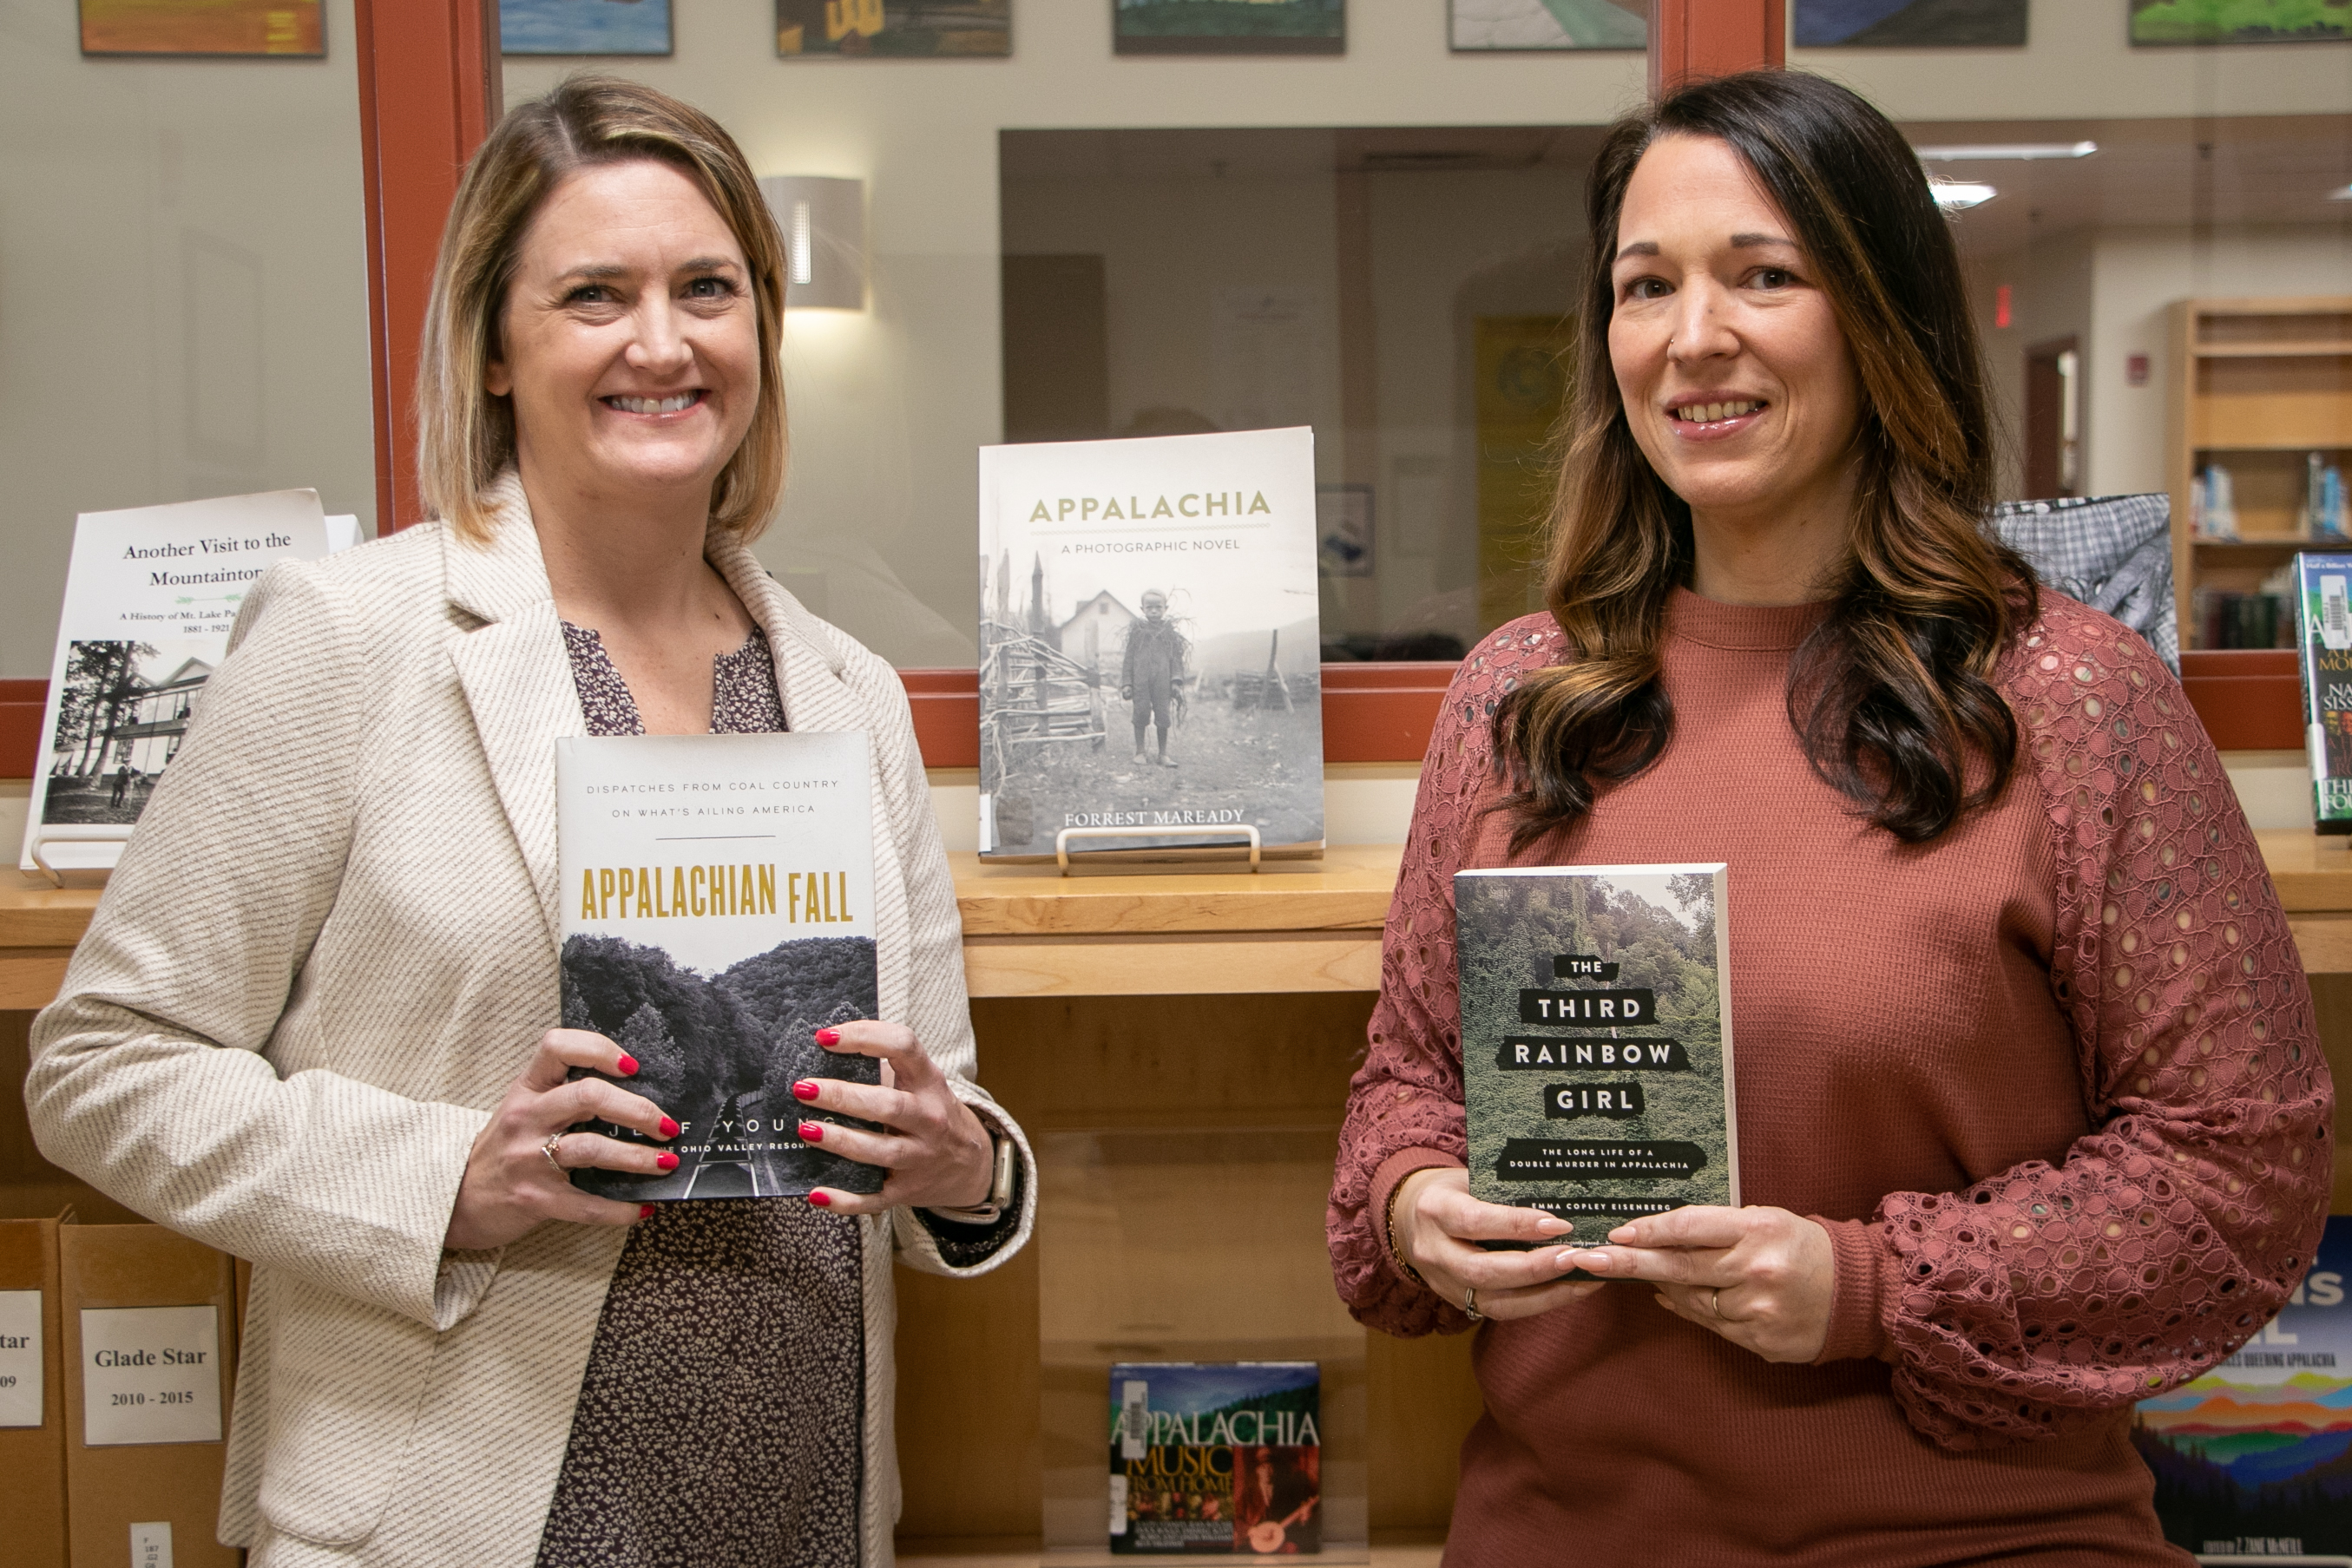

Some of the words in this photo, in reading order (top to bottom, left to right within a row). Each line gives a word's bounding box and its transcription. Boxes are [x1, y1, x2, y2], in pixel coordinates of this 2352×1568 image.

[1029, 490, 1271, 523] APPALACHIA
[122, 542, 195, 560] Another
[199, 537, 240, 554] Visit
[244, 538, 260, 550] to
[265, 532, 292, 548] the
[1061, 545, 1071, 554] A
[1075, 541, 1188, 554] PHOTOGRAPHIC
[1192, 539, 1241, 550] NOVEL
[130, 612, 165, 623] History
[168, 611, 178, 620] of
[180, 611, 196, 620] Mt.
[199, 610, 221, 620] Lake
[225, 609, 236, 618] Pa
[212, 624, 230, 633] 1921
[587, 784, 676, 795] DISPATCHES
[683, 782, 721, 792] FROM
[729, 780, 765, 791] COAL
[772, 779, 839, 791] COUNTRY
[612, 808, 632, 818] ON
[638, 806, 692, 817] WHAT'S
[698, 805, 746, 817] AILING
[752, 804, 816, 816] AMERICA
[1065, 810, 1147, 827] FORREST
[1153, 808, 1245, 825] MAREADY
[581, 863, 777, 921] APPALACHIAN
[788, 870, 854, 924] FALL
[1571, 961, 1602, 973] THE
[1538, 999, 1640, 1018] THIRD
[1515, 1044, 1671, 1064] RAINBOW
[1557, 1090, 1633, 1109] GIRL
[718, 1143, 764, 1152] VALLEY
[95, 1349, 157, 1368] Glade
[162, 1348, 207, 1366] Star
[111, 1393, 145, 1406] 2010
[160, 1391, 194, 1404] 2015
[1127, 1444, 1233, 1476] MUSIC
